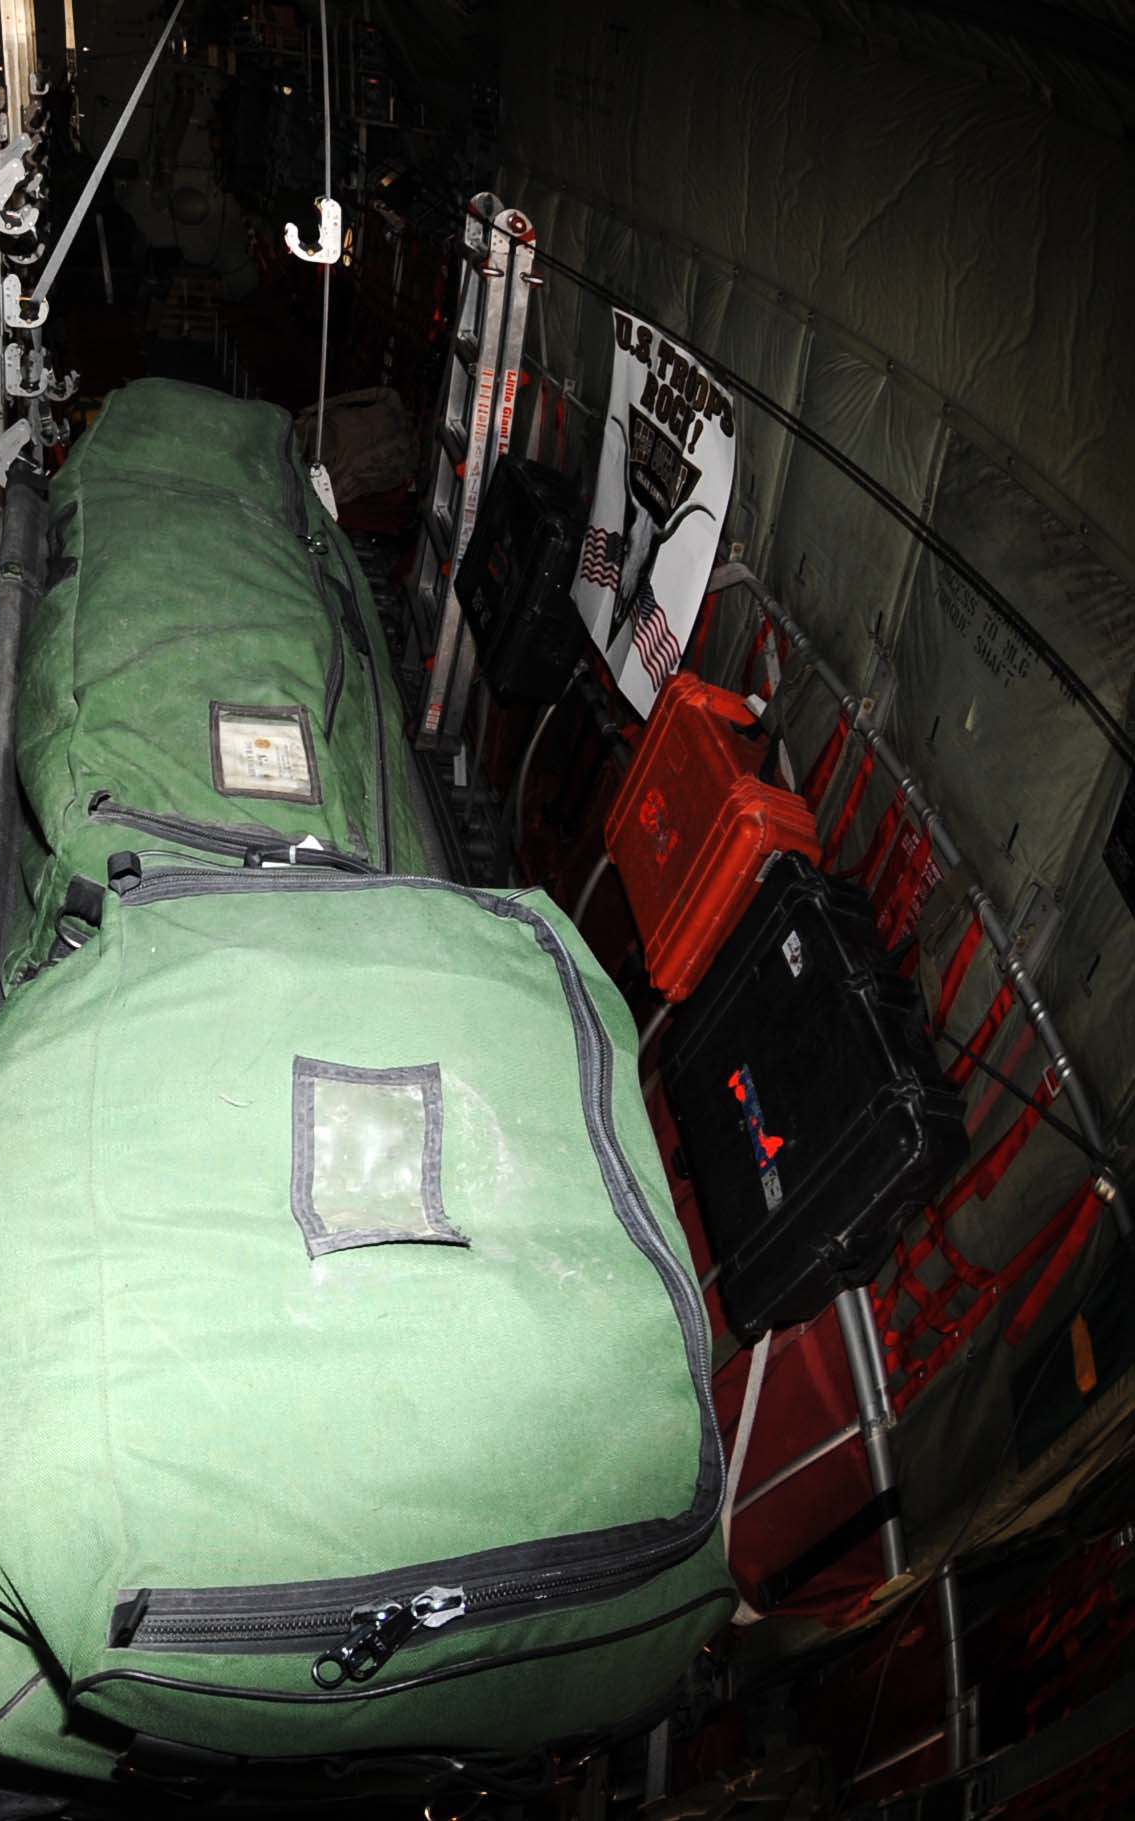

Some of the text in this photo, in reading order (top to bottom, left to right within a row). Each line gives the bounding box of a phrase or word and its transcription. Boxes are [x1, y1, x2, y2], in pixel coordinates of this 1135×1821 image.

[504, 370, 517, 403] Little
[640, 372, 704, 454] ROCK!
[657, 339, 735, 438] TROOPS
[500, 406, 513, 439] Giant
